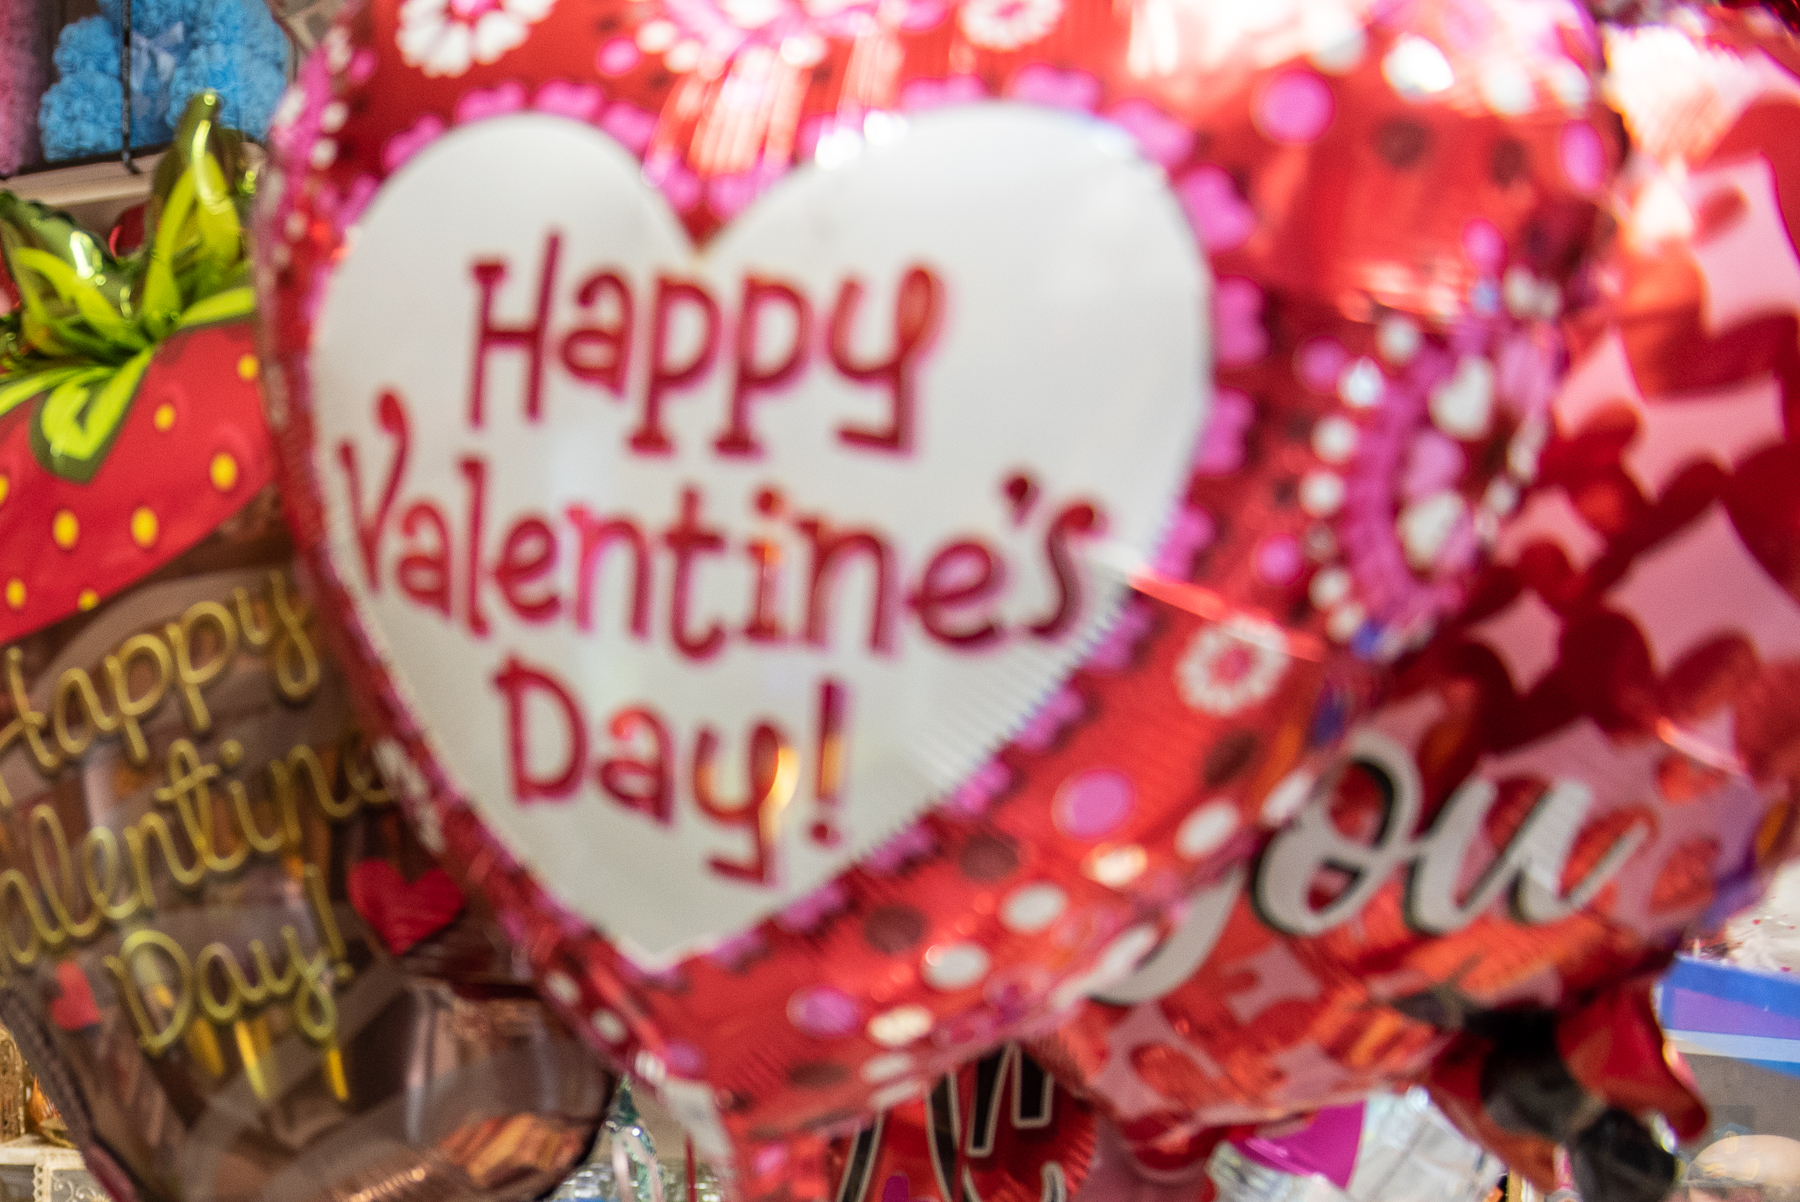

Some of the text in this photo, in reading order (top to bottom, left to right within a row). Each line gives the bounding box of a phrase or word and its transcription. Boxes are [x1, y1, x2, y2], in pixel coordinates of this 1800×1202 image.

[467, 228, 945, 457] Happy
[337, 388, 1107, 663] Valentine's
[492, 650, 856, 887] Day!
[103, 862, 354, 1057] Day!
